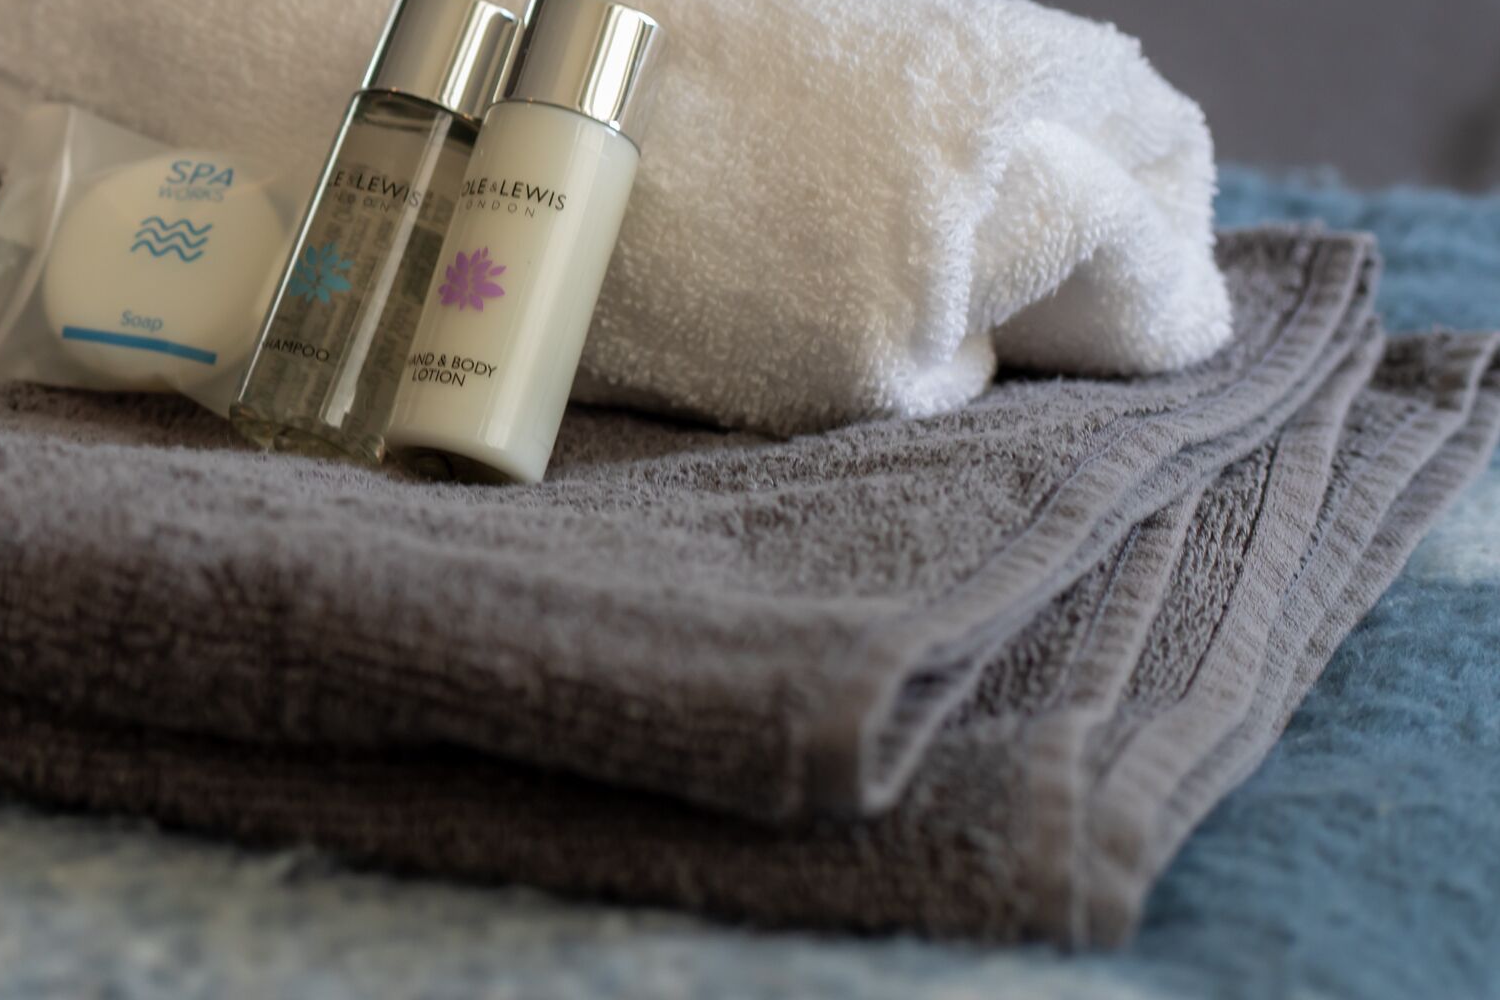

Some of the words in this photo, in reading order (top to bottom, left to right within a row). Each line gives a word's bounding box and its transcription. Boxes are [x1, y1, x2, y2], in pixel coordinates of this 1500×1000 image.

[165, 160, 235, 187] SPA
[158, 186, 225, 203] WORKS
[355, 173, 422, 208] LEWIS
[460, 177, 488, 197] OLE
[499, 178, 568, 211] LEWIS
[464, 199, 536, 219] ONDON
[121, 308, 165, 334] Soap
[262, 338, 330, 362] HAMPOO
[409, 351, 435, 367] AND
[437, 353, 447, 368] &
[451, 355, 498, 379] BODY
[411, 367, 467, 388] LOTION
